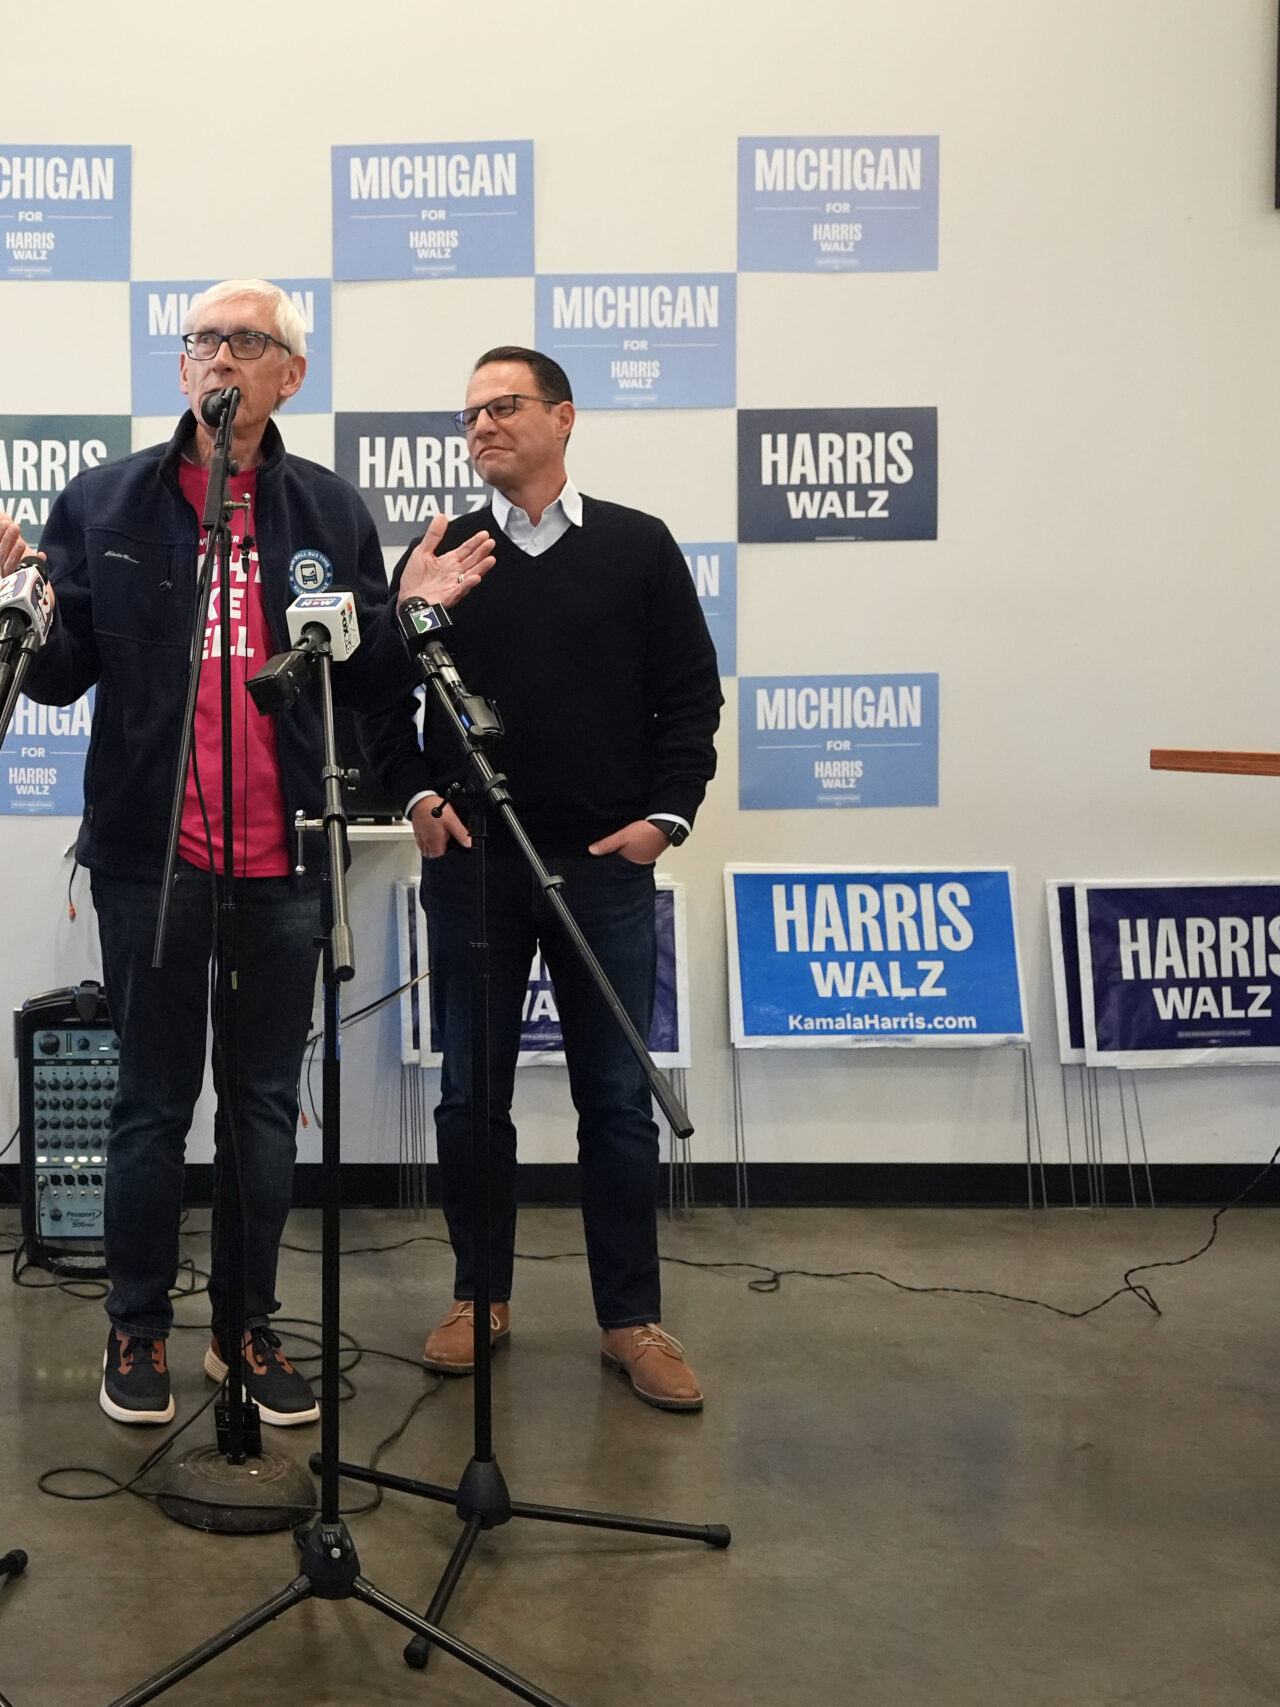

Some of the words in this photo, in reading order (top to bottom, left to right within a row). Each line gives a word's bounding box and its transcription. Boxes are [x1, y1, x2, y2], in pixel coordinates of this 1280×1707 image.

[350, 153, 516, 199] MICHIGAN
[756, 148, 920, 191] MICHIGAN
[19, 211, 43, 222] FOR
[422, 210, 446, 220] FOR
[826, 203, 850, 213] FOR
[6, 232, 54, 250] HARRIS
[410, 230, 458, 248] HARRIS
[813, 223, 862, 242] HARRIS
[13, 250, 47, 260] WALZ
[417, 248, 451, 259] WALZ
[820, 241, 854, 252] WALZ
[553, 286, 718, 328] MICHIGAN
[624, 340, 648, 350] FOR
[611, 361, 660, 379] HARRIS
[619, 379, 652, 389] WALZ
[359, 436, 484, 488] HARR
[762, 431, 913, 485] HARRIS
[787, 491, 888, 518] WALZ
[756, 686, 921, 730] MICHIGAN
[22, 747, 45, 757] FOR
[827, 741, 851, 751] FOR
[9, 768, 56, 784] HARRIS
[815, 761, 863, 778] HARRIS
[16, 785, 49, 795] WALZ
[822, 779, 856, 789] WALZ
[773, 883, 973, 952] HARRIS
[810, 960, 947, 998] WALZ
[1152, 985, 1272, 1020] WALZ
[789, 1013, 976, 1030] KamalaHarris.com
